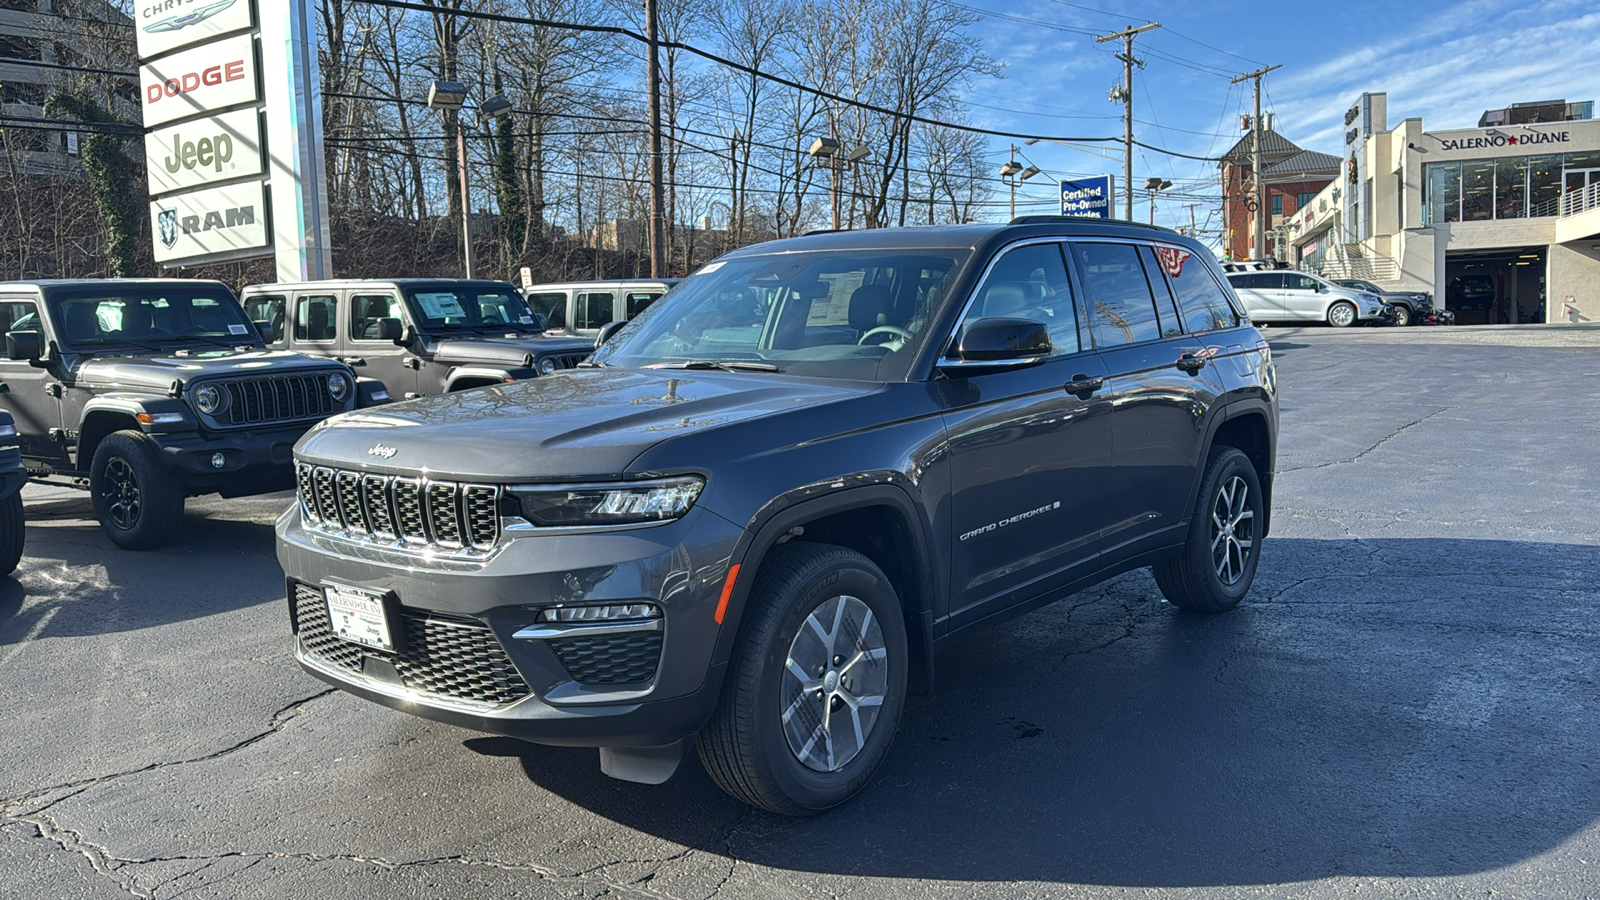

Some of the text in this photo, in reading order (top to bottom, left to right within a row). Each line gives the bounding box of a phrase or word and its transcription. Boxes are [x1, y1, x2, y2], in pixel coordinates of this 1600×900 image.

[143, 0, 194, 18] CHRY
[147, 60, 245, 104] DODGE
[1441, 131, 1570, 150] SALERNO DUANE
[164, 133, 233, 174] Jeep
[1063, 187, 1101, 200] Certified
[1063, 198, 1107, 212] Pre-Owned
[182, 205, 255, 235] RAM
[368, 443, 398, 460] Jeep
[960, 504, 1052, 541] GRAND CHEROKEE
